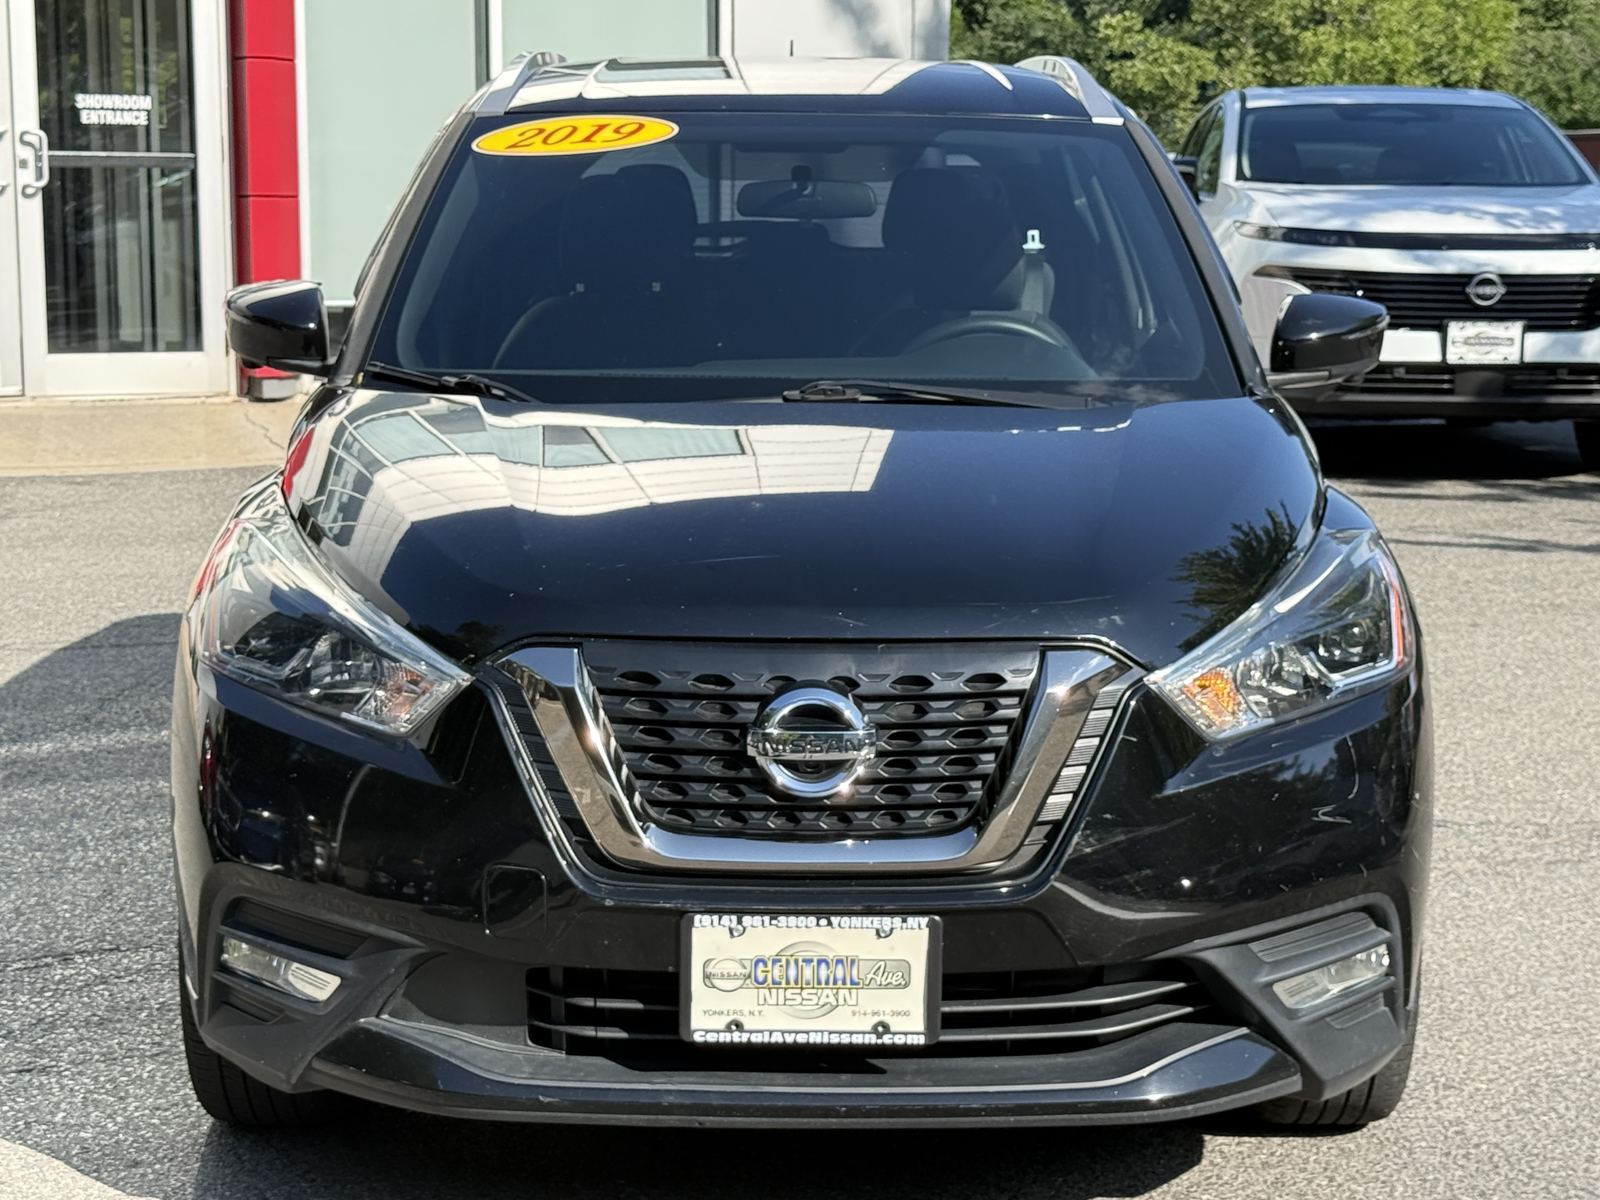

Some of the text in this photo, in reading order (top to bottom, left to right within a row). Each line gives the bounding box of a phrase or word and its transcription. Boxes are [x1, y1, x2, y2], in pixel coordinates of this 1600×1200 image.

[74, 92, 153, 111] SHOWROOM
[80, 109, 149, 126] ENTRANCE
[505, 122, 646, 150] 2019
[758, 737, 860, 756] NISSAN
[753, 956, 908, 988] CENTRAL Ave.
[757, 988, 859, 1006] NISSAN
[702, 1009, 747, 1018] YONKERS,
[851, 1009, 911, 1018] 914-961-3900
[692, 1030, 926, 1045] CentralAveNissan.com
